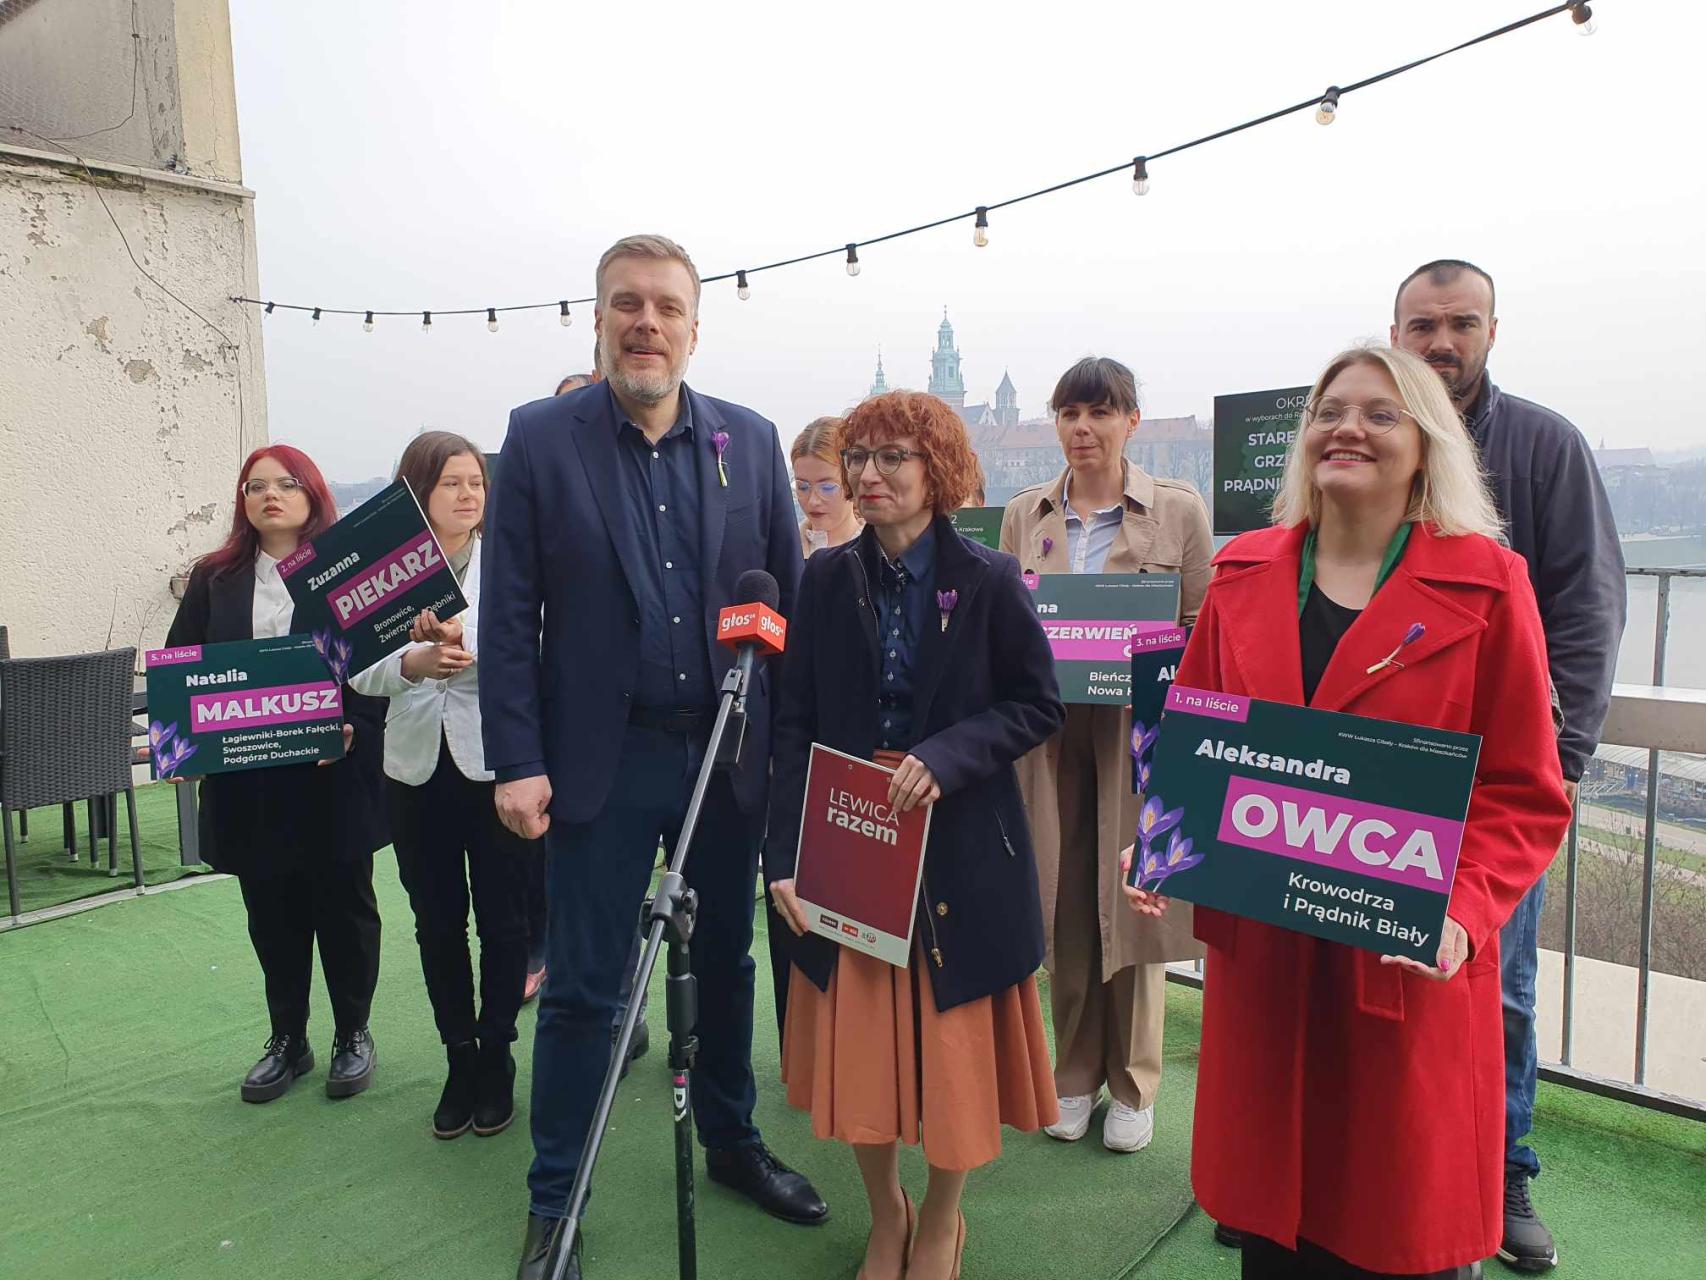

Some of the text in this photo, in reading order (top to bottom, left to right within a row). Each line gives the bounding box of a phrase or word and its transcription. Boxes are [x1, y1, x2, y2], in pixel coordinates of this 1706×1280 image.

[1252, 413, 1282, 423] wyborach
[1248, 430, 1296, 446] STARE
[1224, 478, 1280, 494] PRĄDNI
[288, 560, 296, 568] na
[296, 548, 312, 562] liście
[306, 551, 360, 592] Zuzanna
[336, 539, 440, 620] PIEKARZ
[374, 605, 415, 632] Bronowice,
[1041, 624, 1138, 640] ZERWIEŃ
[1136, 638, 1144, 647] 3.
[1158, 632, 1182, 644] liście
[150, 649, 198, 662] 5. na liście
[186, 668, 248, 687] Natalia
[1087, 686, 1123, 696] Nowa
[197, 688, 338, 724] MALKUSZ
[1174, 692, 1239, 714] 1. na liście
[222, 724, 341, 744] Łagiewniki-Borek Fałęcki,
[222, 742, 282, 754] Swoszowice,
[224, 746, 320, 765] Podgórze Duchackie
[1194, 738, 1351, 786] Aleksandra
[829, 787, 900, 826] LEWICA
[826, 806, 898, 846] razem
[1231, 793, 1444, 882] OWCA
[1288, 872, 1396, 911] Krowodrza
[1282, 894, 1430, 948] i Prądnik Biały
